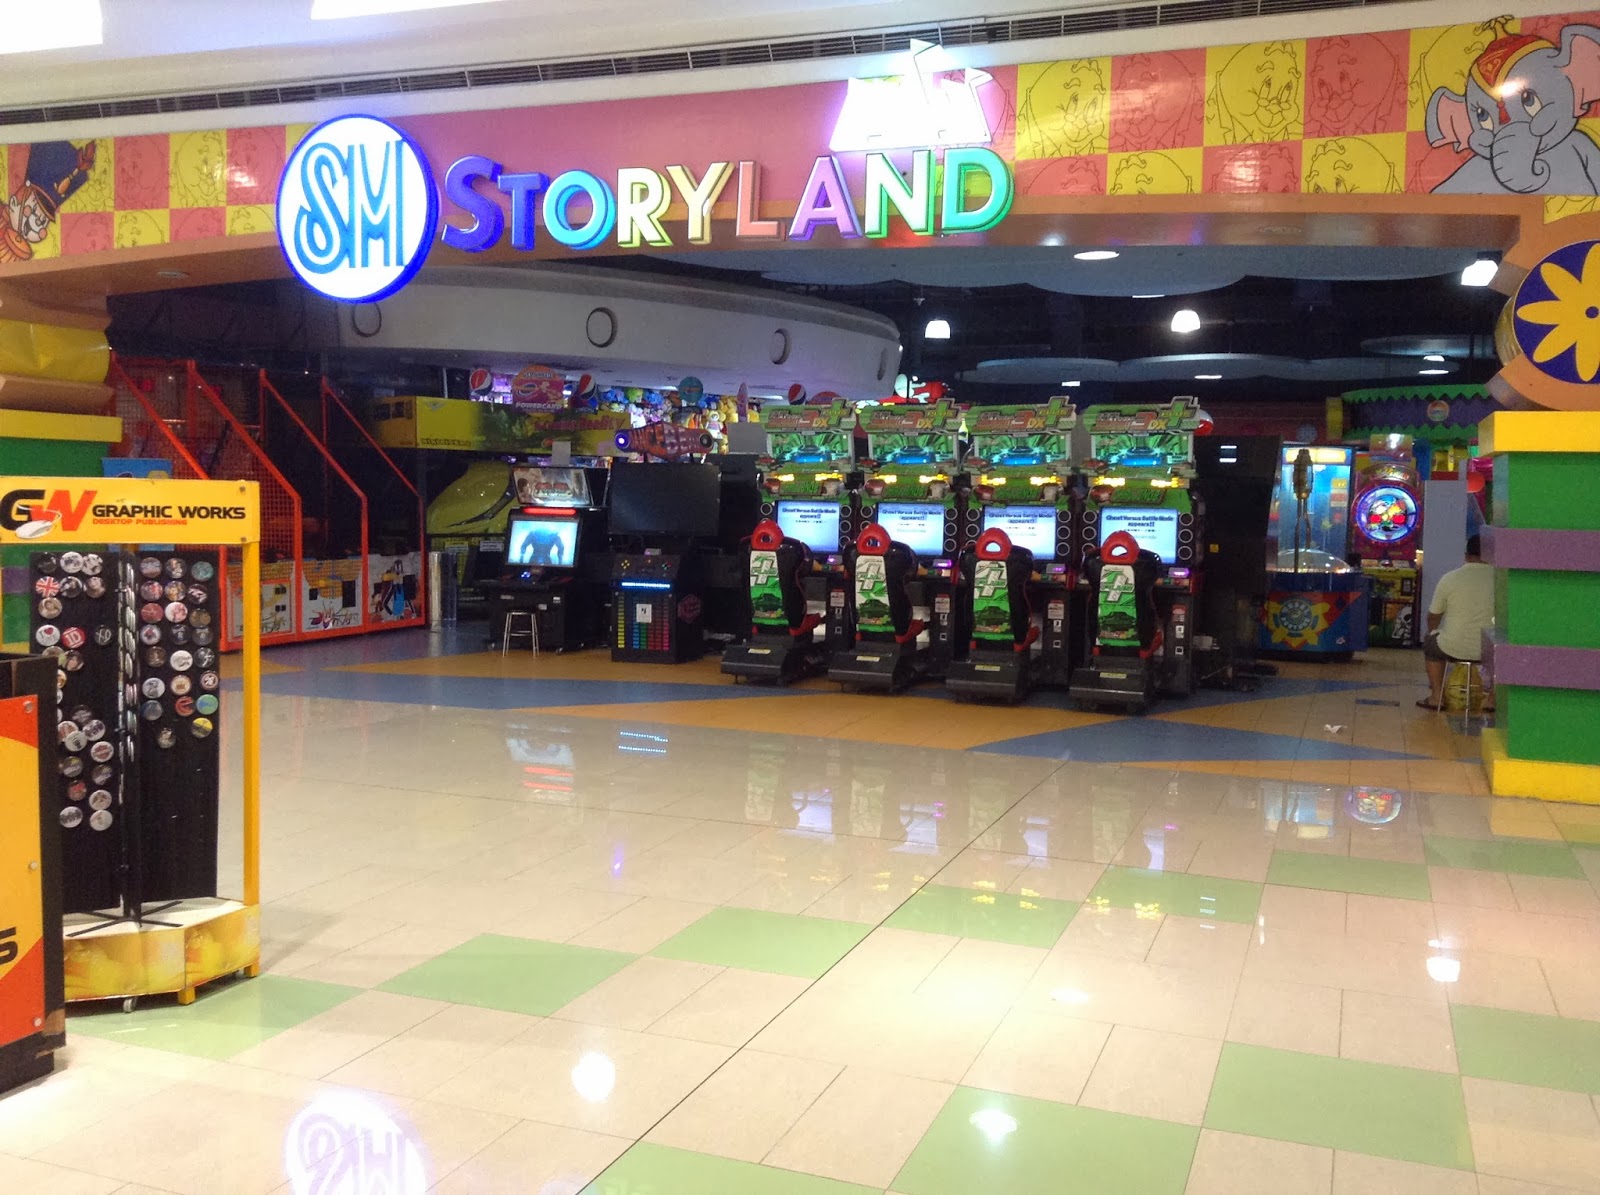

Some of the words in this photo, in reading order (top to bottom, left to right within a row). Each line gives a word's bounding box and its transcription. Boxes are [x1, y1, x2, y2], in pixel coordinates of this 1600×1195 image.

[299, 140, 407, 275] SM
[440, 146, 1016, 252] STORYLAND
[92, 504, 173, 518] GRAPHIC
[178, 506, 246, 519] WORKS
[135, 518, 188, 526] PUBLISHING
